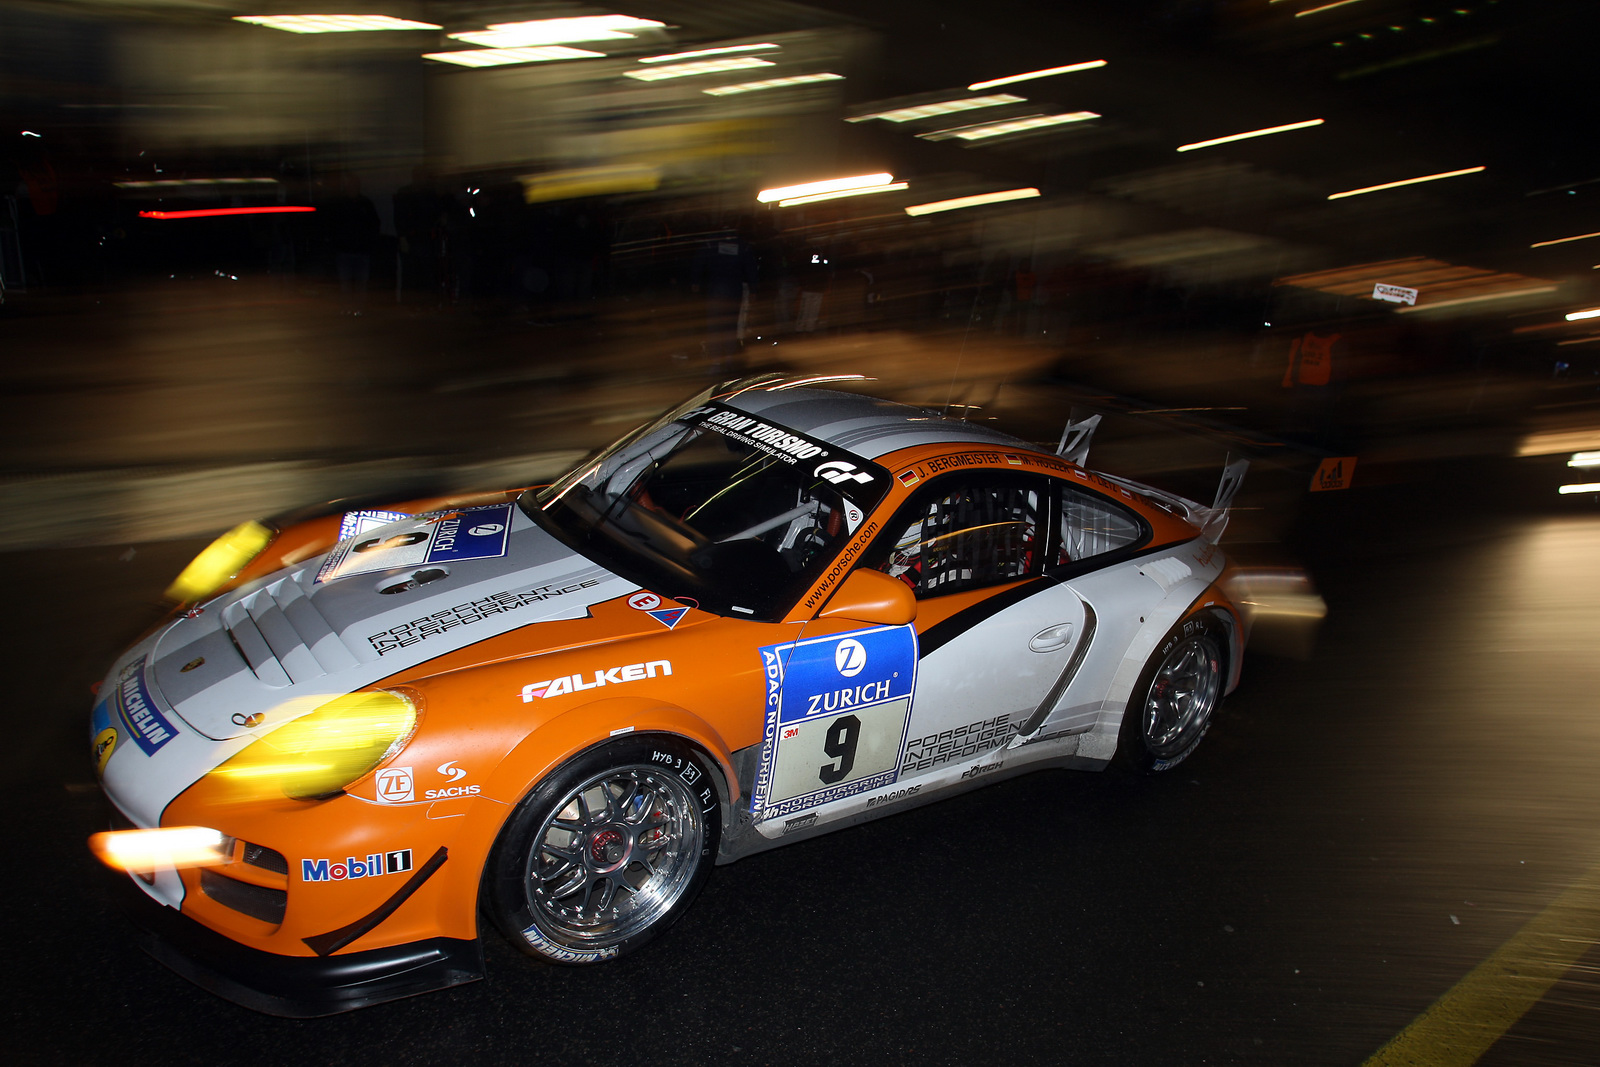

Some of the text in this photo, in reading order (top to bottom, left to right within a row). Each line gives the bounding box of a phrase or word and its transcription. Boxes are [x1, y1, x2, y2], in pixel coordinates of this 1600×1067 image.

[699, 421, 798, 466] THE REAL DRIVING SIMULATOR
[708, 411, 822, 460] GRAN TURISMO
[919, 453, 1002, 479] J. BERGMEISTER
[433, 518, 461, 553] ZURICH
[804, 521, 879, 609] www.porsche.com
[367, 590, 516, 642] PORSCHE
[372, 584, 553, 649] INTELLIGENT
[376, 579, 600, 656] PERFORMANCE
[633, 595, 656, 608] E
[517, 659, 673, 703] FALKEN
[805, 679, 891, 716] ZURICH
[122, 675, 171, 745] MICHELIN
[753, 651, 780, 813] ADAC NORDRHEIN
[783, 727, 799, 739] 3M
[818, 713, 862, 785] 9
[905, 713, 1011, 752] PORSCHE
[651, 750, 673, 765] HYB
[960, 760, 1004, 780] FÖRCH
[380, 772, 410, 798] ZF
[425, 783, 481, 800] SACHS
[699, 787, 712, 805] FL
[779, 777, 894, 816] NORDSCHLEIFE
[780, 772, 895, 810] NÜRBURGRING
[302, 854, 383, 882] Mobil
[522, 929, 599, 962] MICHELIN
